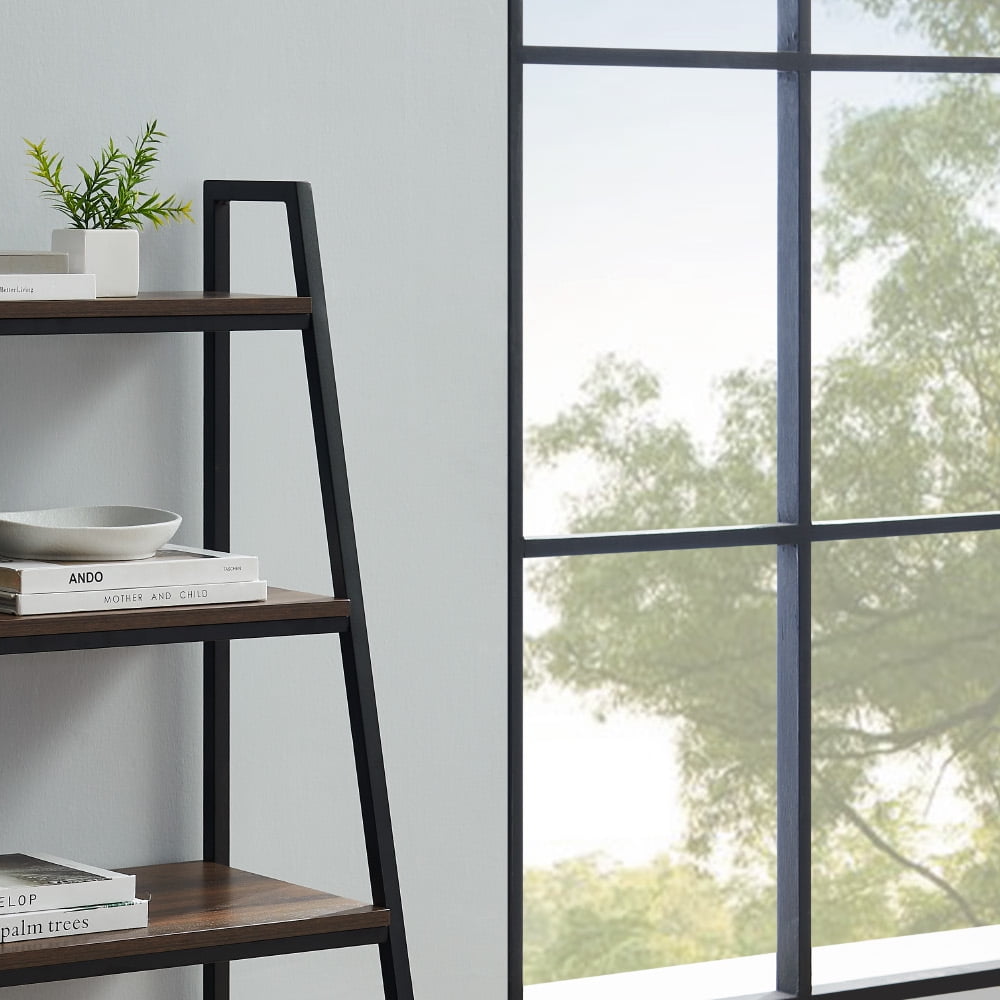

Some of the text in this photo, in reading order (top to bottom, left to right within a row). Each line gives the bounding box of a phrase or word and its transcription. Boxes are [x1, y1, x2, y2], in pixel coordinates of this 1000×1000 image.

[68, 571, 104, 584] ANDO
[104, 589, 208, 604] MOTHER AND CHILD
[1, 919, 43, 943] palm
[48, 918, 89, 933] trees
